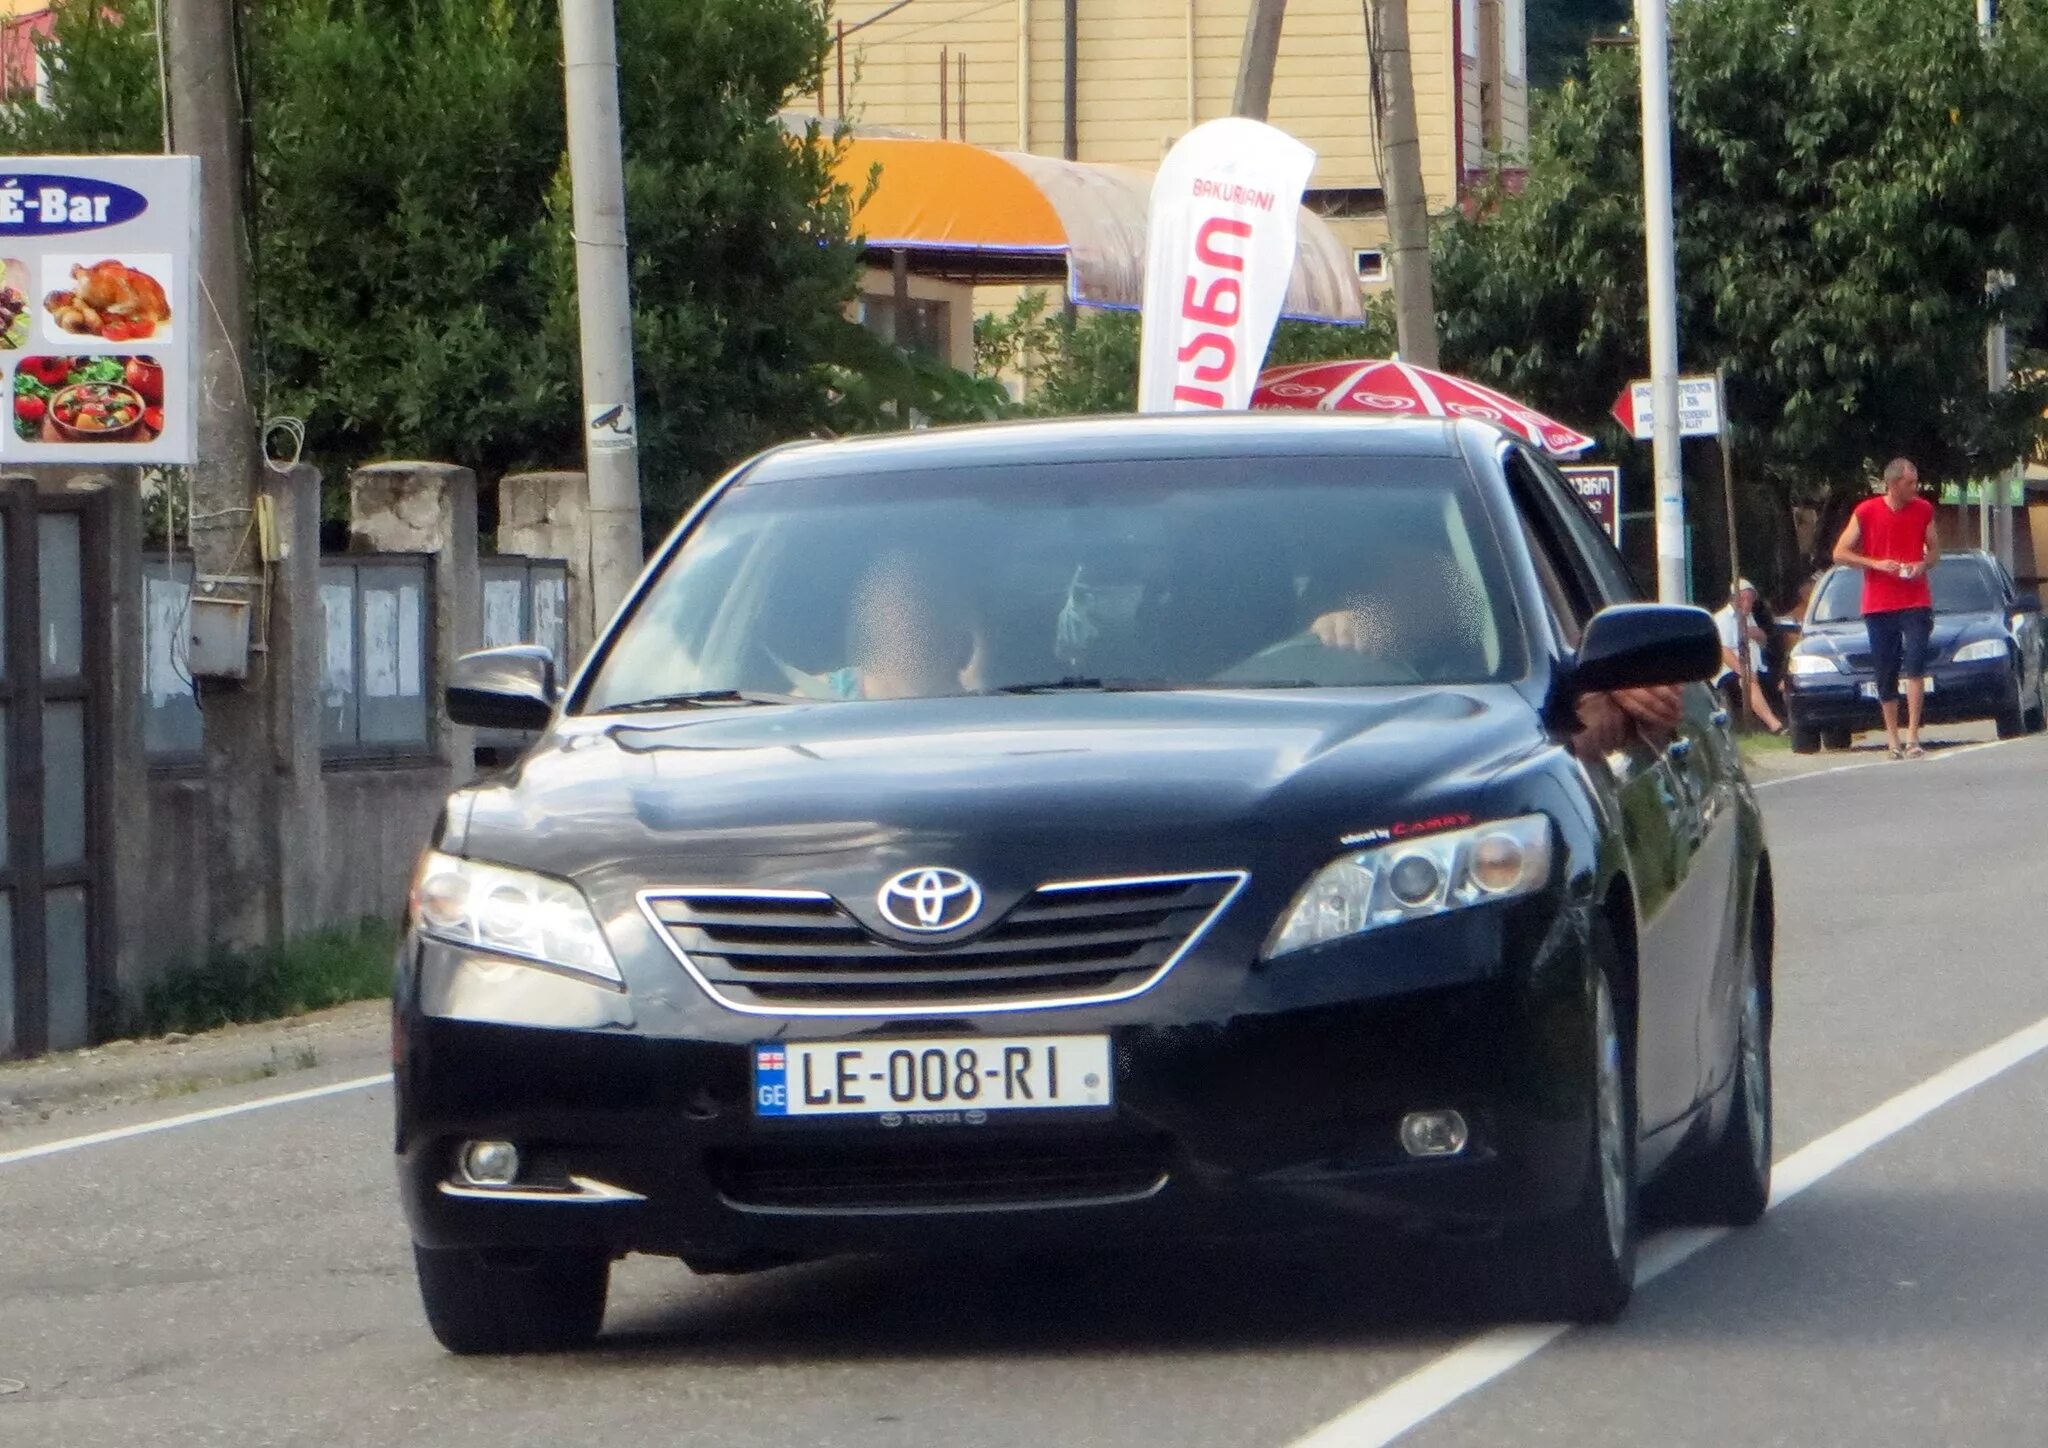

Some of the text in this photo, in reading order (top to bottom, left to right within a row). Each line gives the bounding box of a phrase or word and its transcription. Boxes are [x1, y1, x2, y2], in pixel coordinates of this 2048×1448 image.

[1192, 178, 1276, 212] BAKURIANI
[803, 1045, 1059, 1106] LE-008-RI
[758, 1085, 785, 1106] GE
[907, 1113, 960, 1124] TOYOTA
